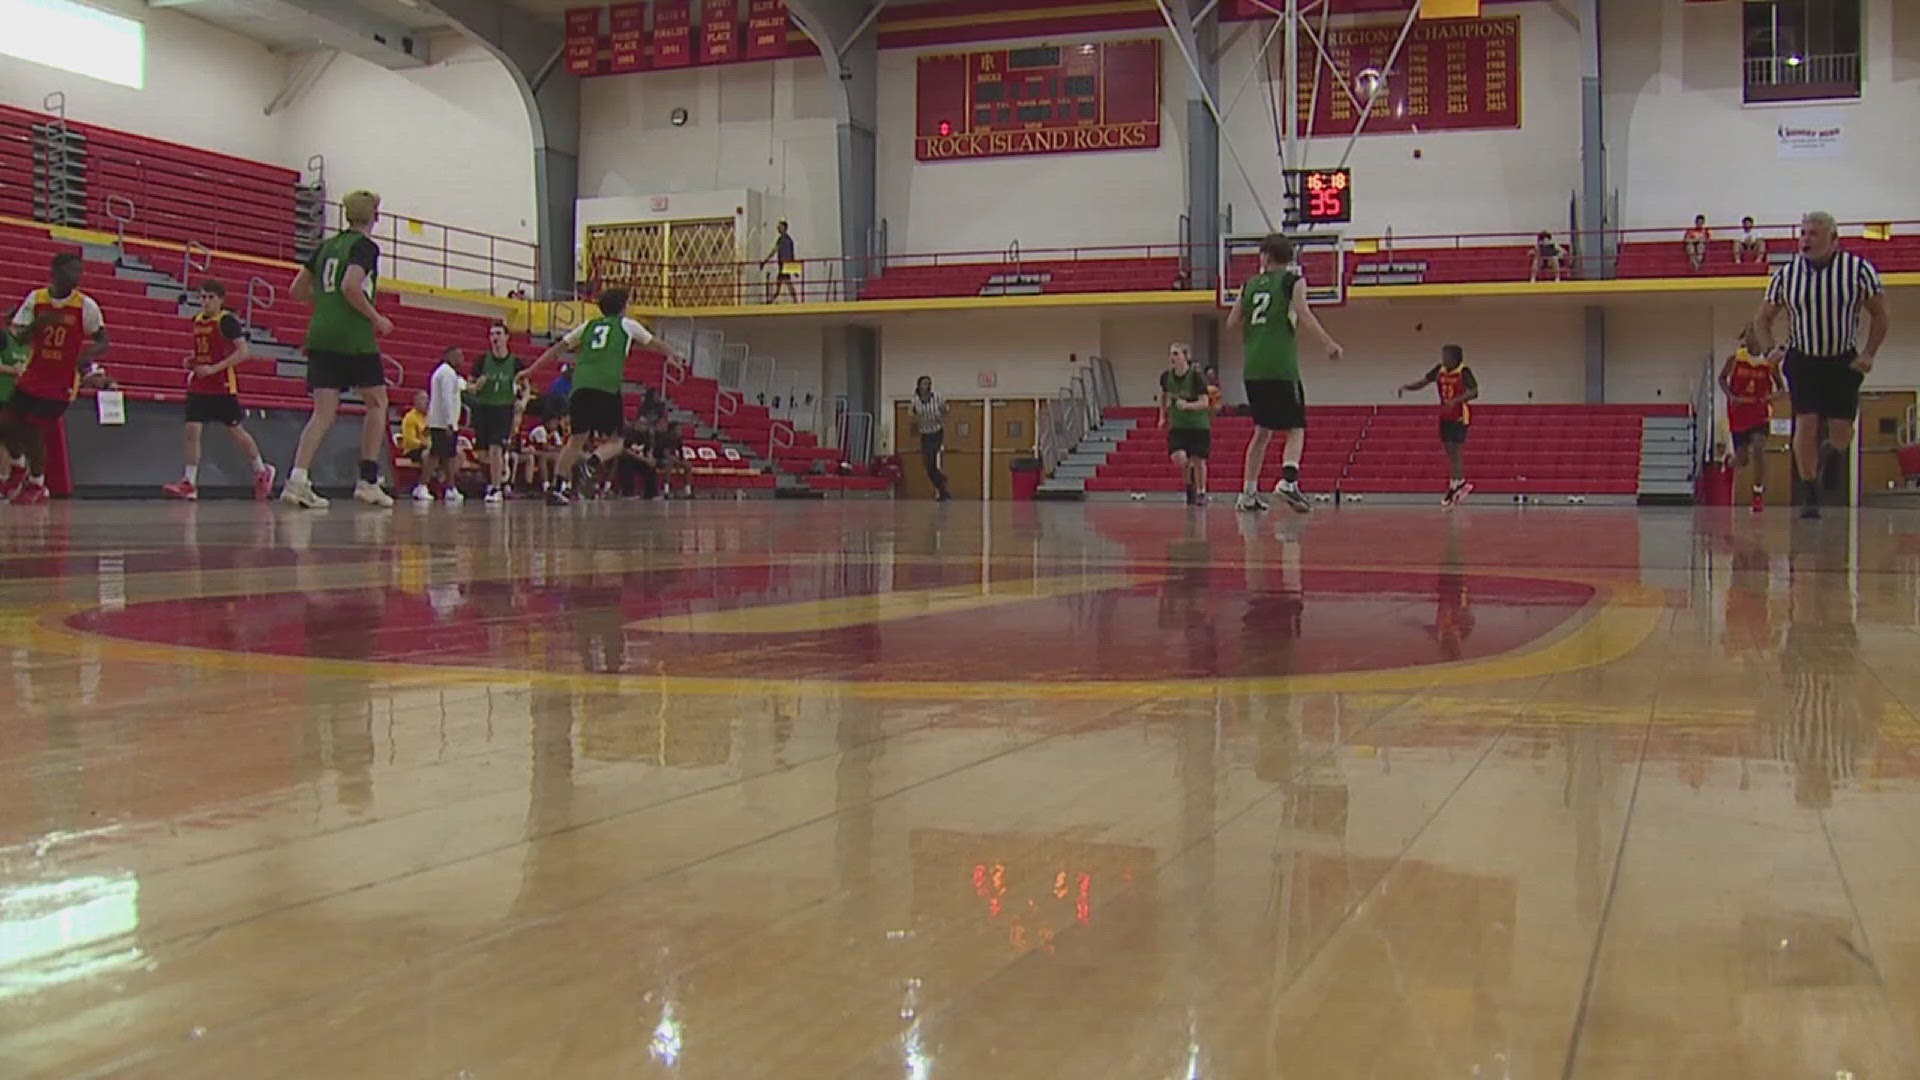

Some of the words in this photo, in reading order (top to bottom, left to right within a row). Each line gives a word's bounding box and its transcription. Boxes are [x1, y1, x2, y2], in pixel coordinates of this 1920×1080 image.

[655, 26, 688, 38] FINALIST
[750, 16, 784, 29] FINALIST
[707, 31, 731, 42] PLACE
[1328, 27, 1408, 46] REGIONA
[1413, 22, 1515, 40] CHAMPIONS
[570, 46, 592, 56] PLACE
[615, 40, 638, 51] PLACE
[926, 136, 983, 158] ROCK
[990, 131, 1068, 154] ISLAND
[1073, 126, 1146, 149] ROCKS
[1308, 172, 1346, 190] 16:18
[1310, 189, 1340, 215] 35
[322, 257, 339, 293] 0
[1251, 292, 1271, 325] 2
[43, 325, 66, 347] 20
[591, 325, 609, 350] 3
